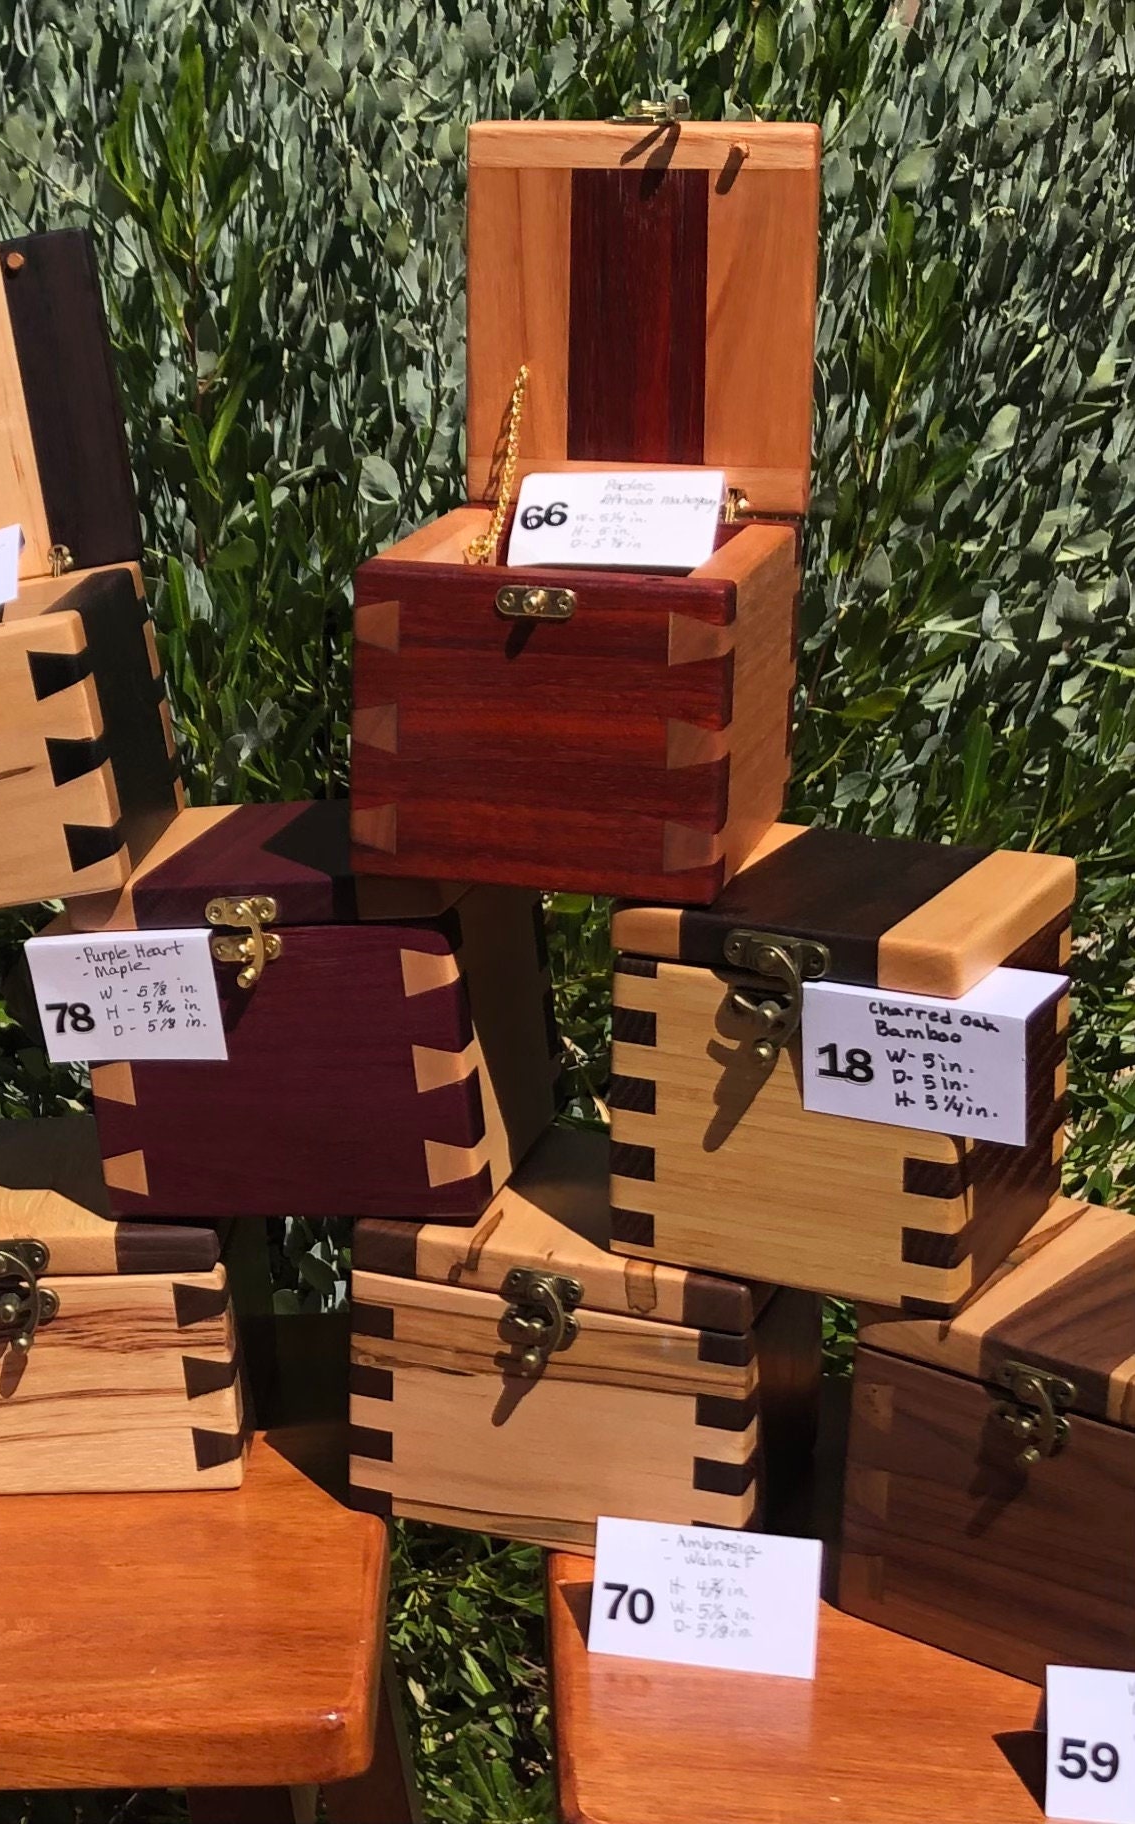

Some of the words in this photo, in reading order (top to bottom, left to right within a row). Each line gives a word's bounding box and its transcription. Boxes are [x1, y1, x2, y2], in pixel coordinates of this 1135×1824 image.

[520, 502, 569, 530] 66
[135, 940, 184, 956] Heart
[95, 961, 151, 979] Maple
[137, 985, 148, 998] 5
[176, 977, 198, 993] in.
[142, 1001, 152, 1013] 5
[184, 998, 201, 1012] in.
[45, 1002, 96, 1034] 78
[147, 1020, 158, 1033] 5
[185, 1013, 207, 1028] in.
[874, 1019, 963, 1044] Bamboo
[818, 1043, 874, 1083] 18
[925, 1094, 939, 1111] 5
[965, 1096, 998, 1118] in.
[603, 1582, 655, 1624] 70
[1058, 1737, 1120, 1783] 59
